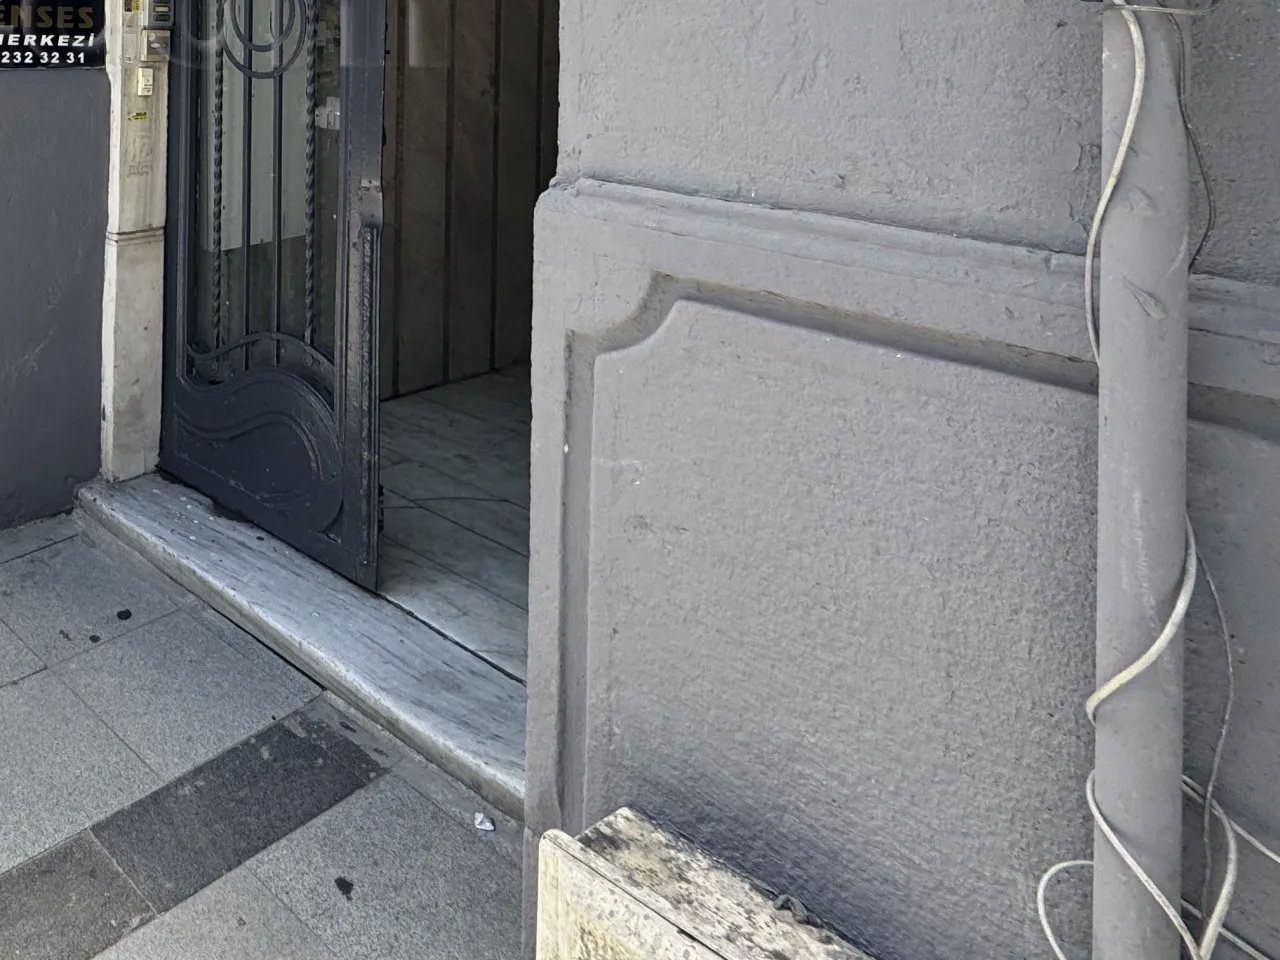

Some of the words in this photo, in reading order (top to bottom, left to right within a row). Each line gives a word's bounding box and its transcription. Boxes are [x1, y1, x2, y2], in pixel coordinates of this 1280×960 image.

[1, 51, 34, 64] 232
[39, 51, 60, 64] 32
[66, 52, 86, 64] 31
